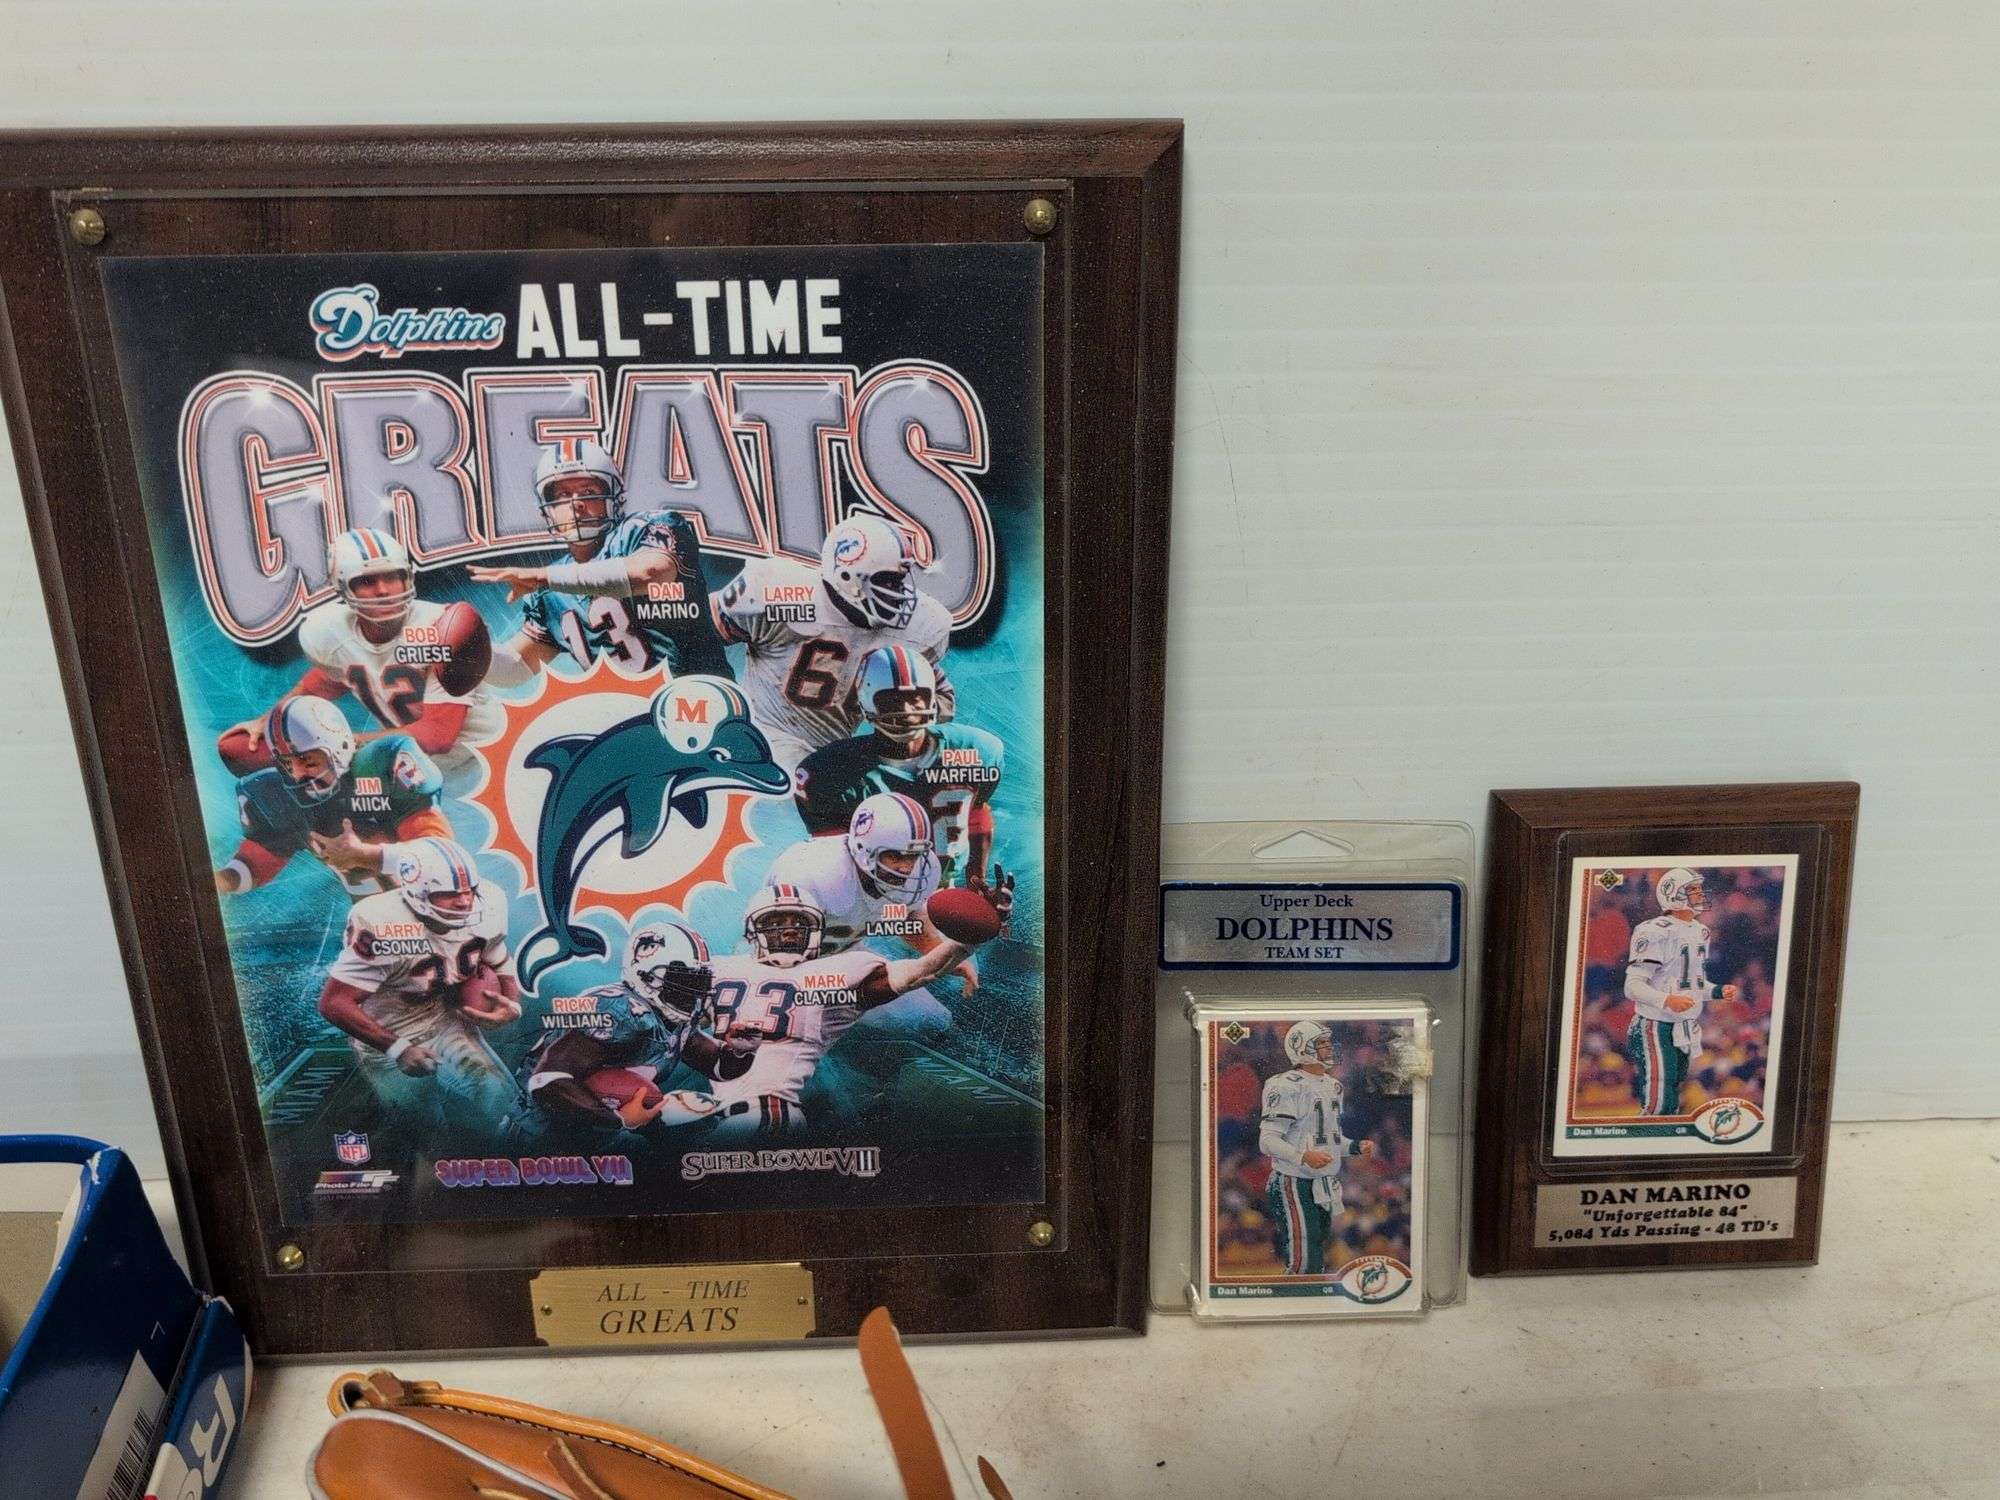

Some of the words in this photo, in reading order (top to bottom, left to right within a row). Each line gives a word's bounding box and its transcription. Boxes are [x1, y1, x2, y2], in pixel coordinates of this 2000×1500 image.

[309, 283, 506, 362] Dolphins
[517, 279, 844, 358] ALL-TIME
[178, 358, 996, 649] GREATS
[648, 582, 684, 601] DAN
[764, 586, 815, 602] LARRY
[637, 603, 700, 620] MARINO
[766, 605, 816, 622] LITTLE
[404, 627, 440, 644] BOB
[560, 596, 651, 673] 13
[395, 647, 452, 664] GRIESE
[346, 664, 427, 729] 12
[675, 696, 709, 724] M
[942, 749, 982, 766] PAUL
[926, 768, 1000, 784] WARFIELD
[355, 778, 382, 795] JIM
[351, 797, 392, 812] KIICK
[1260, 894, 1310, 911] Upper
[1314, 894, 1353, 908] Deck
[881, 904, 907, 919] JIM
[375, 923, 423, 937] LARRY
[866, 921, 923, 935] LANGER
[1215, 917, 1393, 941] DOLPHINS
[371, 939, 432, 955] CSONKA
[1264, 946, 1311, 959] TEAM
[1314, 946, 1344, 959] SET
[804, 975, 847, 989] MARK
[553, 997, 598, 1013] RICKY
[794, 989, 857, 1006] CLAYTON
[713, 977, 796, 1043] 83
[542, 1014, 612, 1029] WILLIAMS
[1573, 1127, 1592, 1136] Dan
[1594, 1126, 1628, 1136] Marino
[340, 1146, 368, 1158] NFL
[435, 1158, 520, 1187] SUPER
[520, 1156, 598, 1185] BOWL
[590, 1155, 634, 1185] VII
[681, 1151, 756, 1181] SUPER
[756, 1149, 833, 1172] BOWL
[1580, 1188, 1639, 1205] DAN
[1646, 1183, 1751, 1204] MARINO
[1583, 1206, 1713, 1223] "Unforgettable
[1719, 1204, 1747, 1218] 84"
[1599, 1226, 1629, 1238] Yds
[1635, 1223, 1700, 1237] Passing
[1741, 1220, 1779, 1232] TD's
[597, 1282, 647, 1301] ALL
[688, 1279, 750, 1299] TIME
[1217, 1287, 1236, 1295] Dan
[1239, 1286, 1273, 1295] Marino
[1322, 1286, 1334, 1294] QB
[600, 1306, 740, 1334] GREATS
